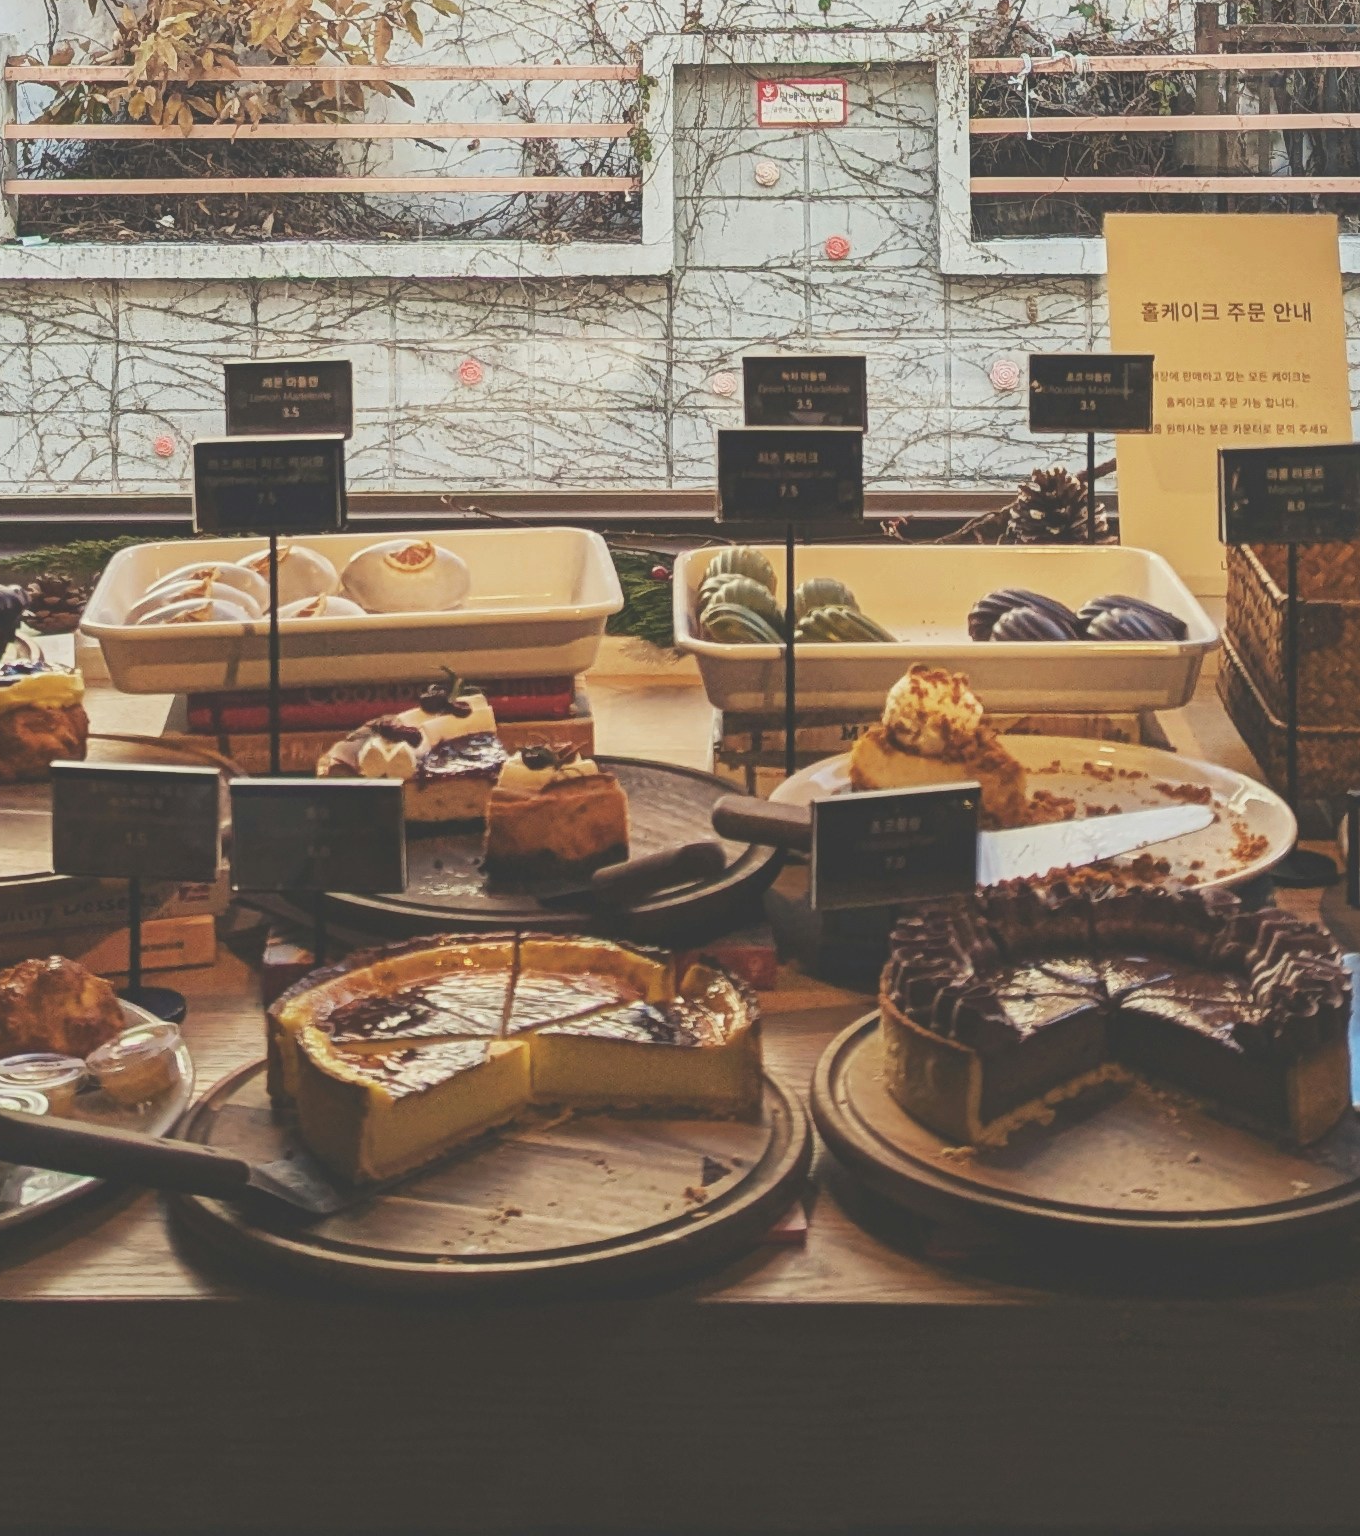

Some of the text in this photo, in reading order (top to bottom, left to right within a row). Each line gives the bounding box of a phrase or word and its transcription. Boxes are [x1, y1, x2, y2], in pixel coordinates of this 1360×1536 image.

[1141, 301, 1312, 323] 홀케이크 주문 안내
[1183, 371, 1222, 383] 판매하고
[1226, 371, 1244, 383] 있는
[1248, 371, 1268, 383] 모든
[1272, 371, 1311, 383] 케이크는
[1166, 397, 1215, 409] 홀케이크로
[1219, 397, 1238, 409] 주문
[1242, 397, 1261, 409] 가능
